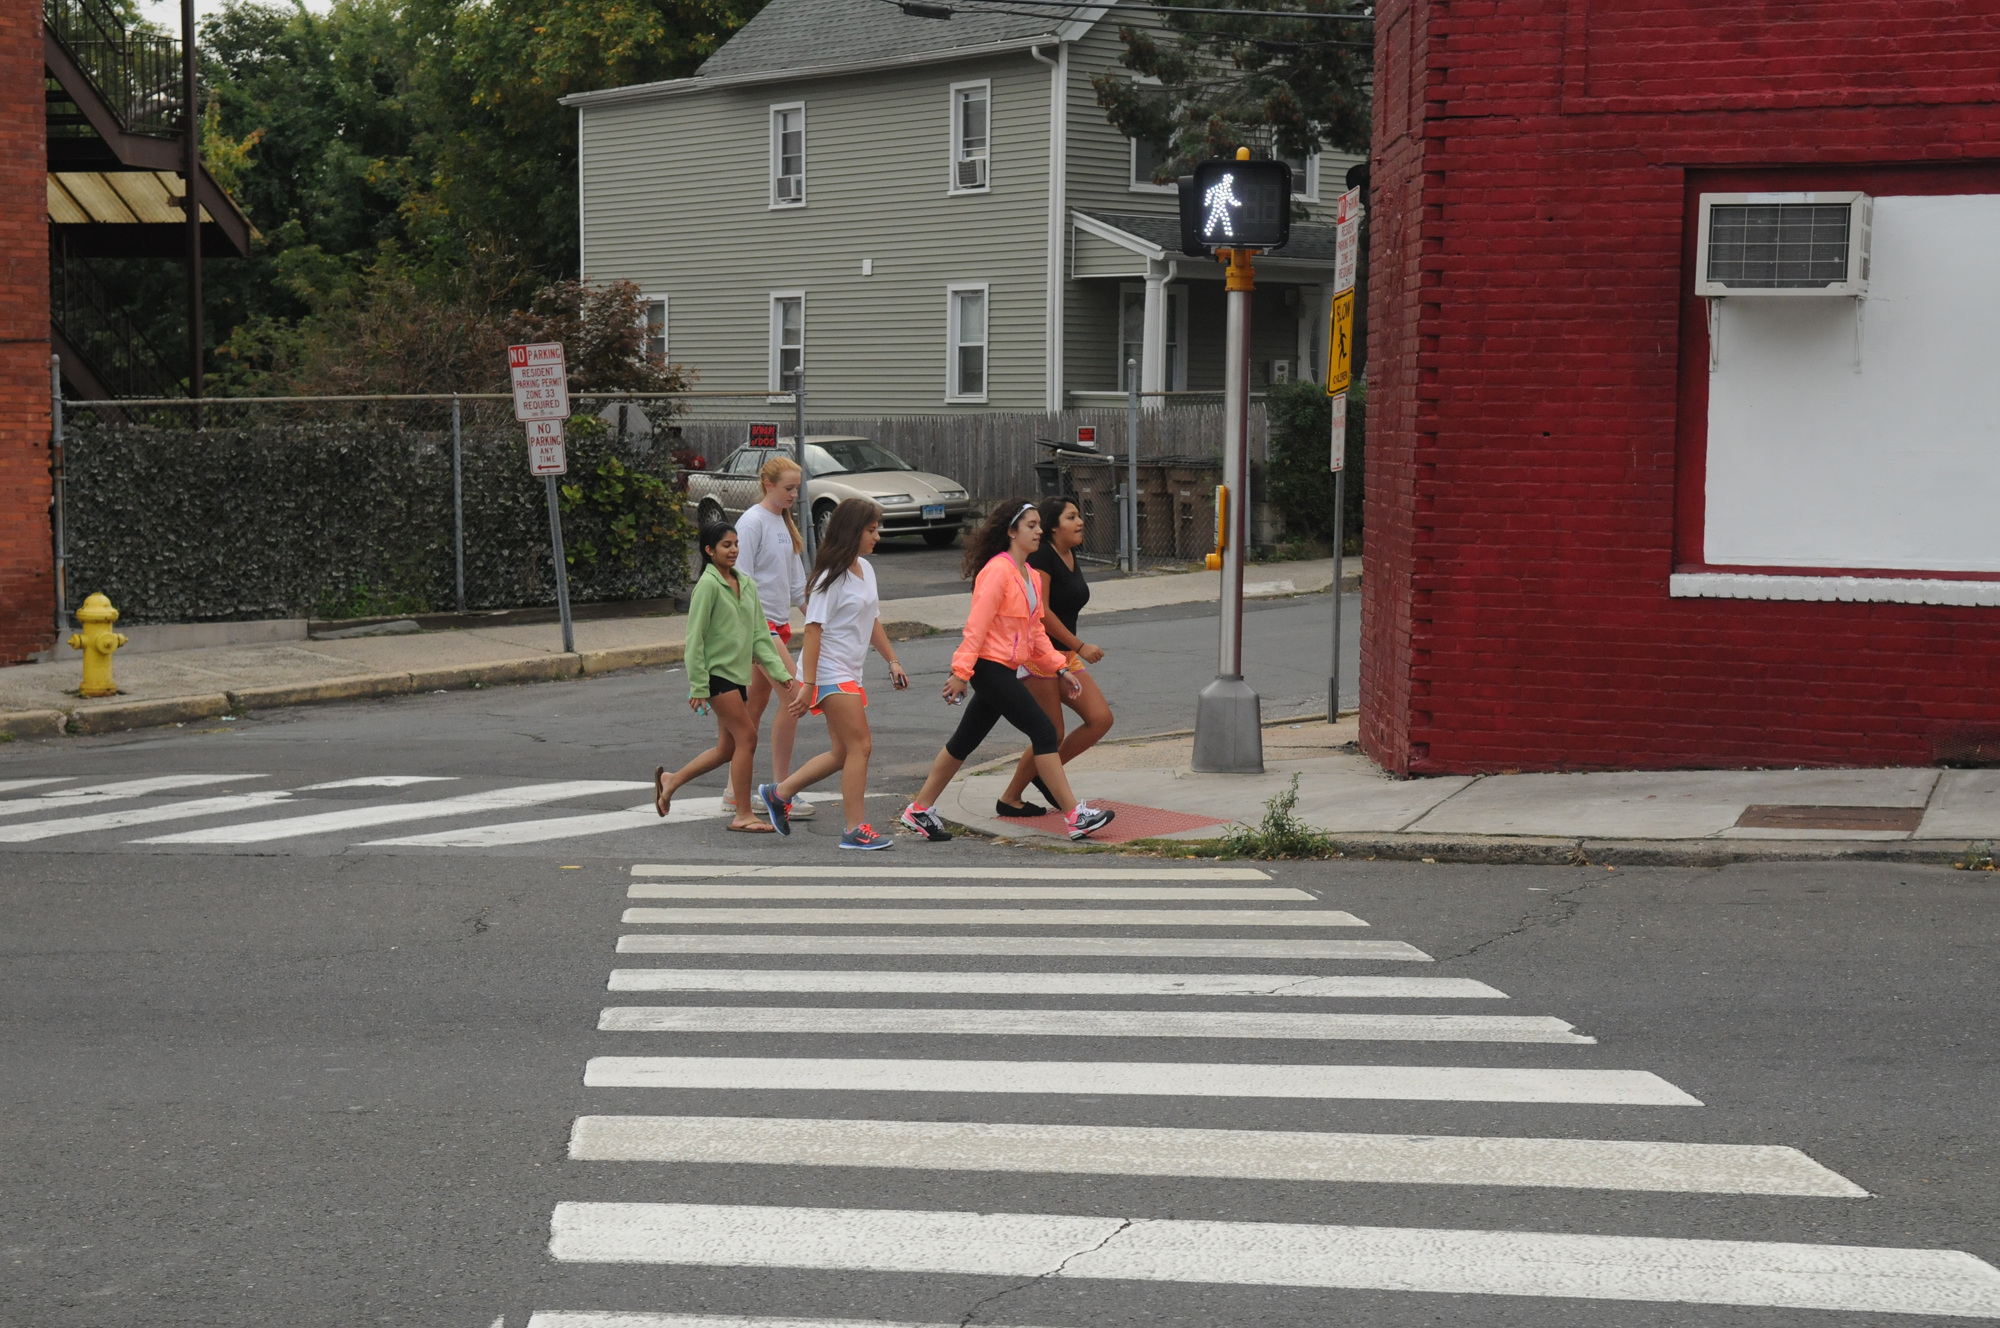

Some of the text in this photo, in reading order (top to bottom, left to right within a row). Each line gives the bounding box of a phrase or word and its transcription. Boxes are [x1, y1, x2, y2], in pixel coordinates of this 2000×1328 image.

[1339, 198, 1346, 217] NO
[1336, 299, 1352, 323] SLOW
[510, 348, 561, 363] NO PARKING
[521, 367, 554, 378] RESIDENT
[516, 377, 562, 389] PARKING PERMIT
[526, 388, 556, 400] ZONE 33
[523, 400, 560, 411] REQUIRED
[537, 423, 552, 434] NO
[751, 425, 776, 435] BEWARE
[530, 435, 561, 447] PARKING
[758, 437, 776, 447] DOG
[540, 447, 554, 455] ANY
[539, 455, 556, 463] TIME
